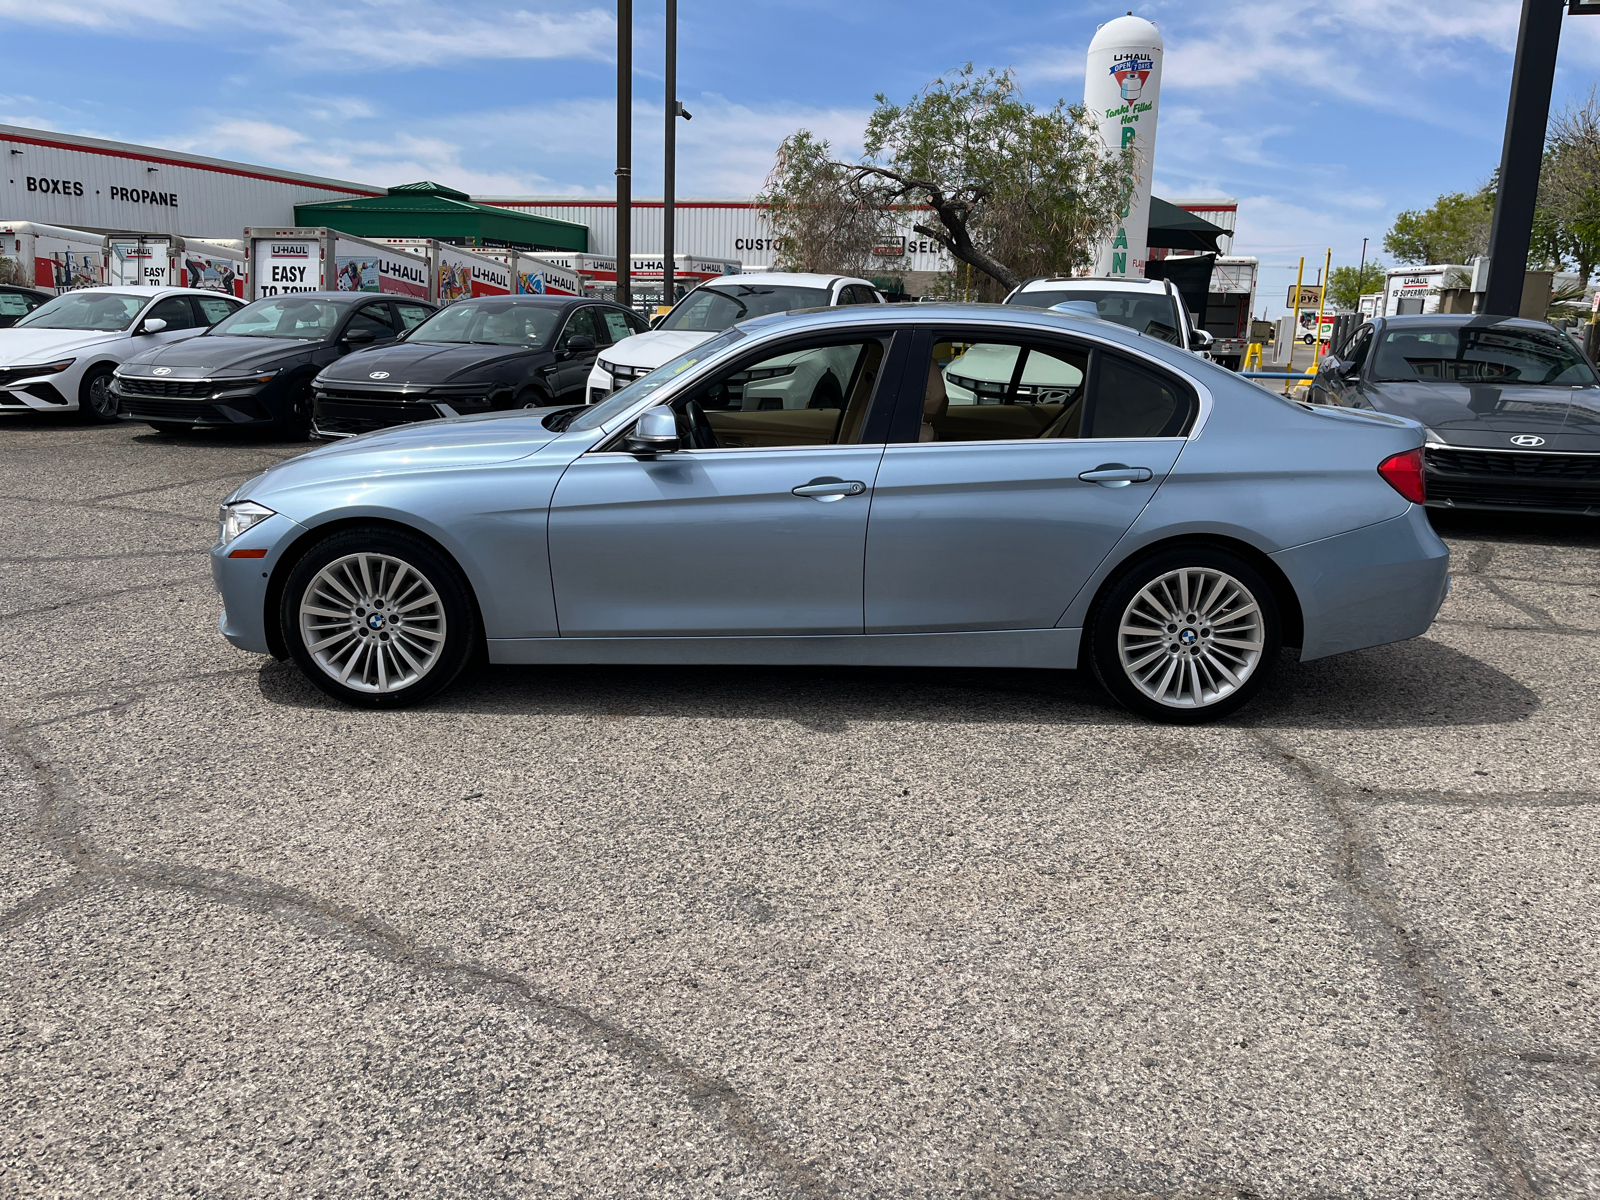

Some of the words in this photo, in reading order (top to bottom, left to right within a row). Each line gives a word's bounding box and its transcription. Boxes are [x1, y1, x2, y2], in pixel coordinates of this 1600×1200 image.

[1115, 62, 1131, 71] OPEN
[1105, 105, 1129, 119] Tanks
[1133, 101, 1152, 114] Filled
[1121, 114, 1139, 125] Here
[26, 176, 84, 197] BOXES
[110, 185, 178, 207] PROPANE
[272, 246, 308, 254] U-HAUL
[379, 259, 425, 283] U-HAUL
[593, 261, 616, 271] U-HAUL
[634, 261, 680, 270] U-HAL
[701, 262, 722, 273] U-HAUL
[144, 267, 166, 277] EASY
[272, 266, 307, 282] EASY
[472, 265, 508, 287] U-HAUL
[545, 272, 576, 292] U-HAUL
[1404, 277, 1428, 285] U-HAUL
